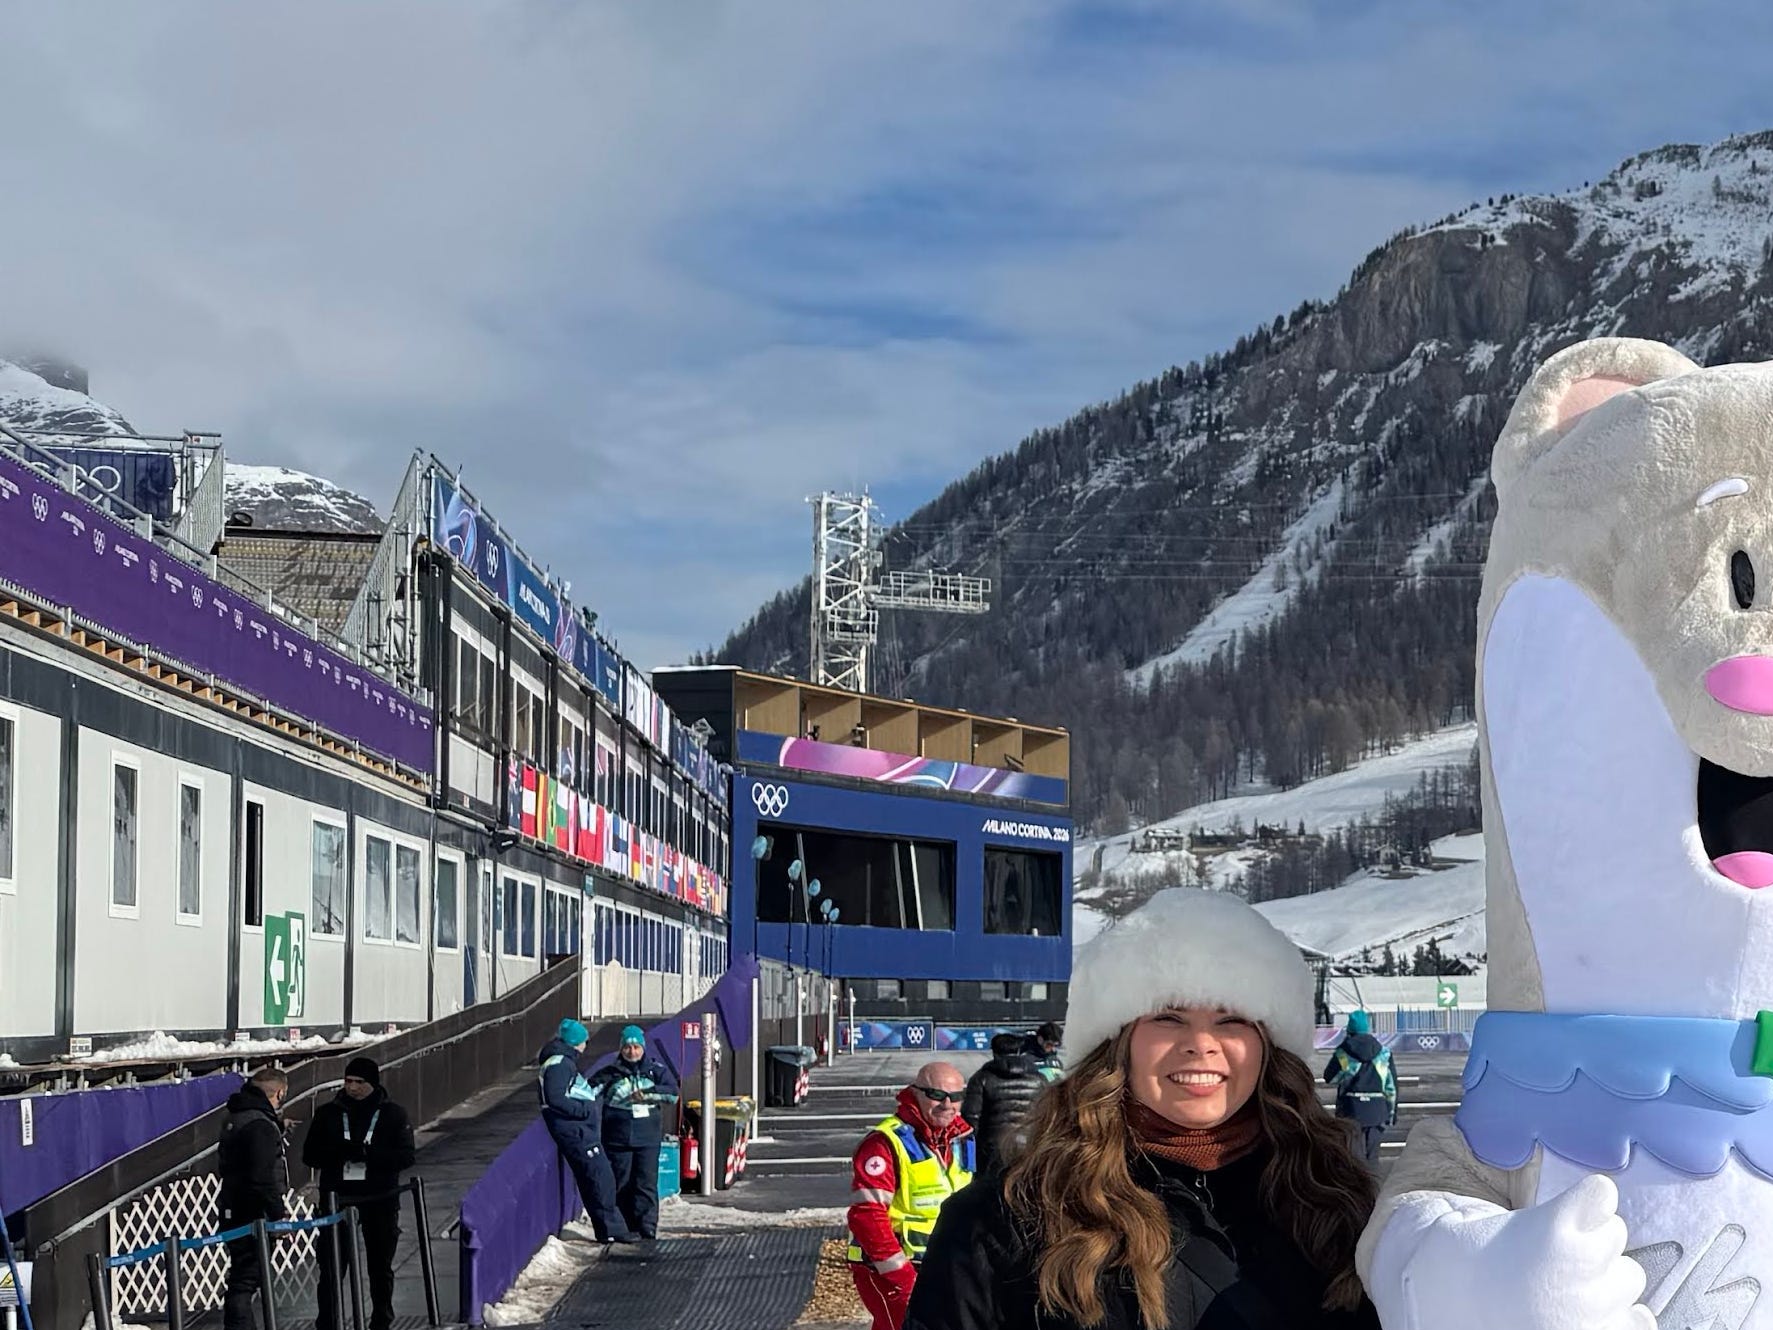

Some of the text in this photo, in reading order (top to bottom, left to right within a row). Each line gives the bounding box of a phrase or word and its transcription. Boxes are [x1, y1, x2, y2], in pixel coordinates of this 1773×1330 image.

[982, 818, 1070, 842] MILANO CORTINA 2026
